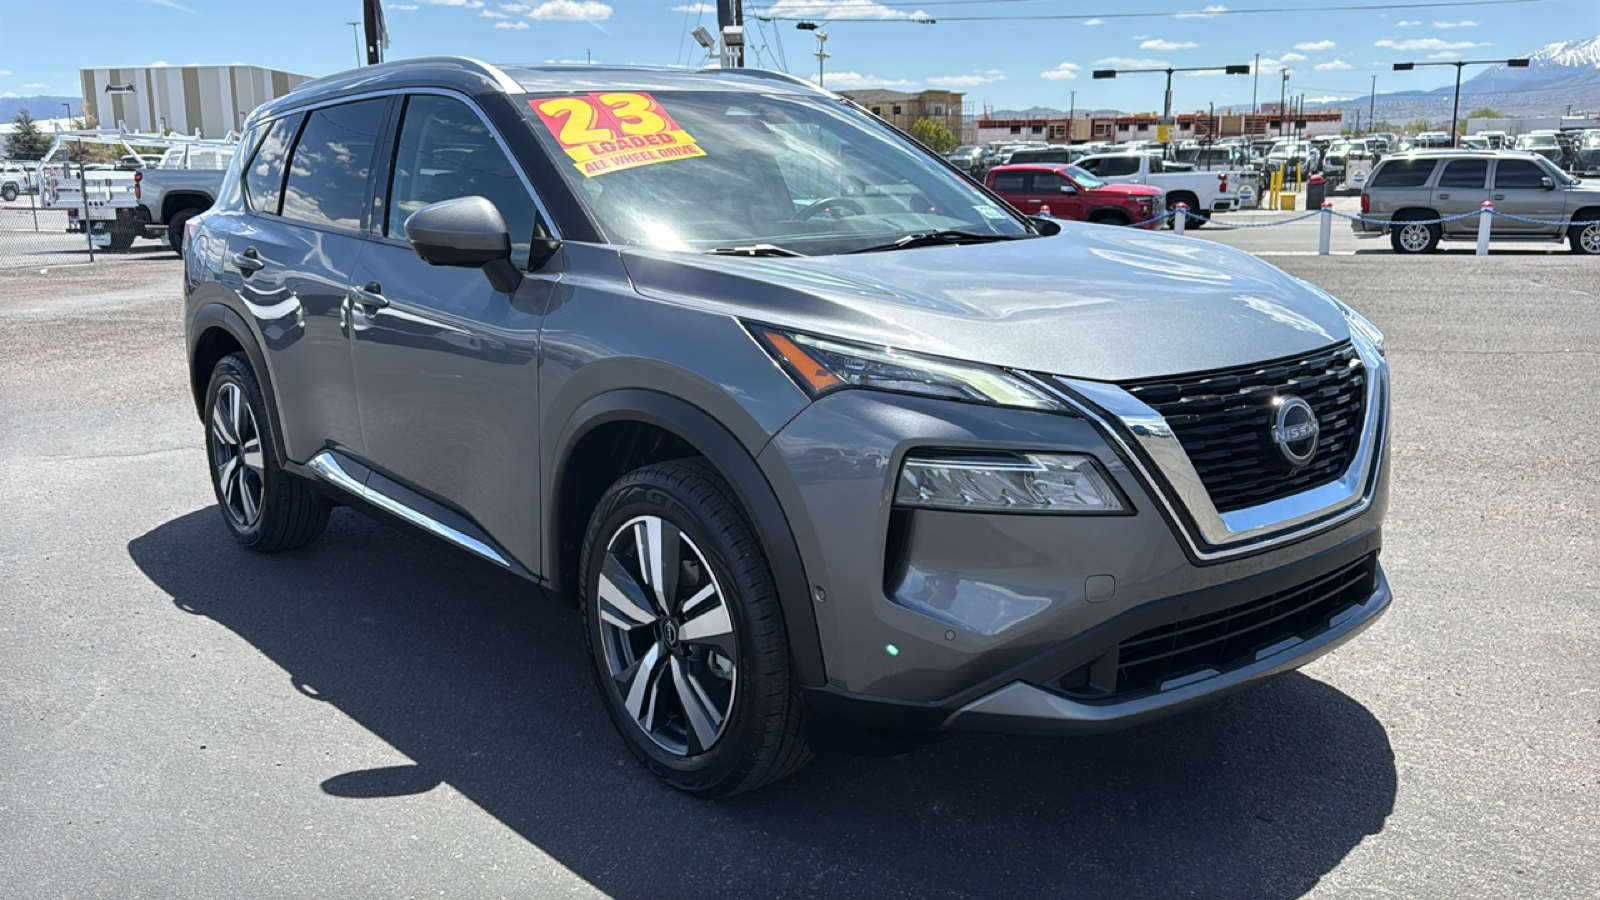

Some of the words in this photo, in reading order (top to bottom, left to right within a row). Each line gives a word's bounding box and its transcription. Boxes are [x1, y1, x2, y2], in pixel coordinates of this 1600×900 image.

[538, 92, 669, 145] 23
[588, 133, 677, 156] LOADED
[584, 160, 610, 174] ALL
[610, 151, 659, 167] WHEEL
[659, 146, 700, 159] DRIVE
